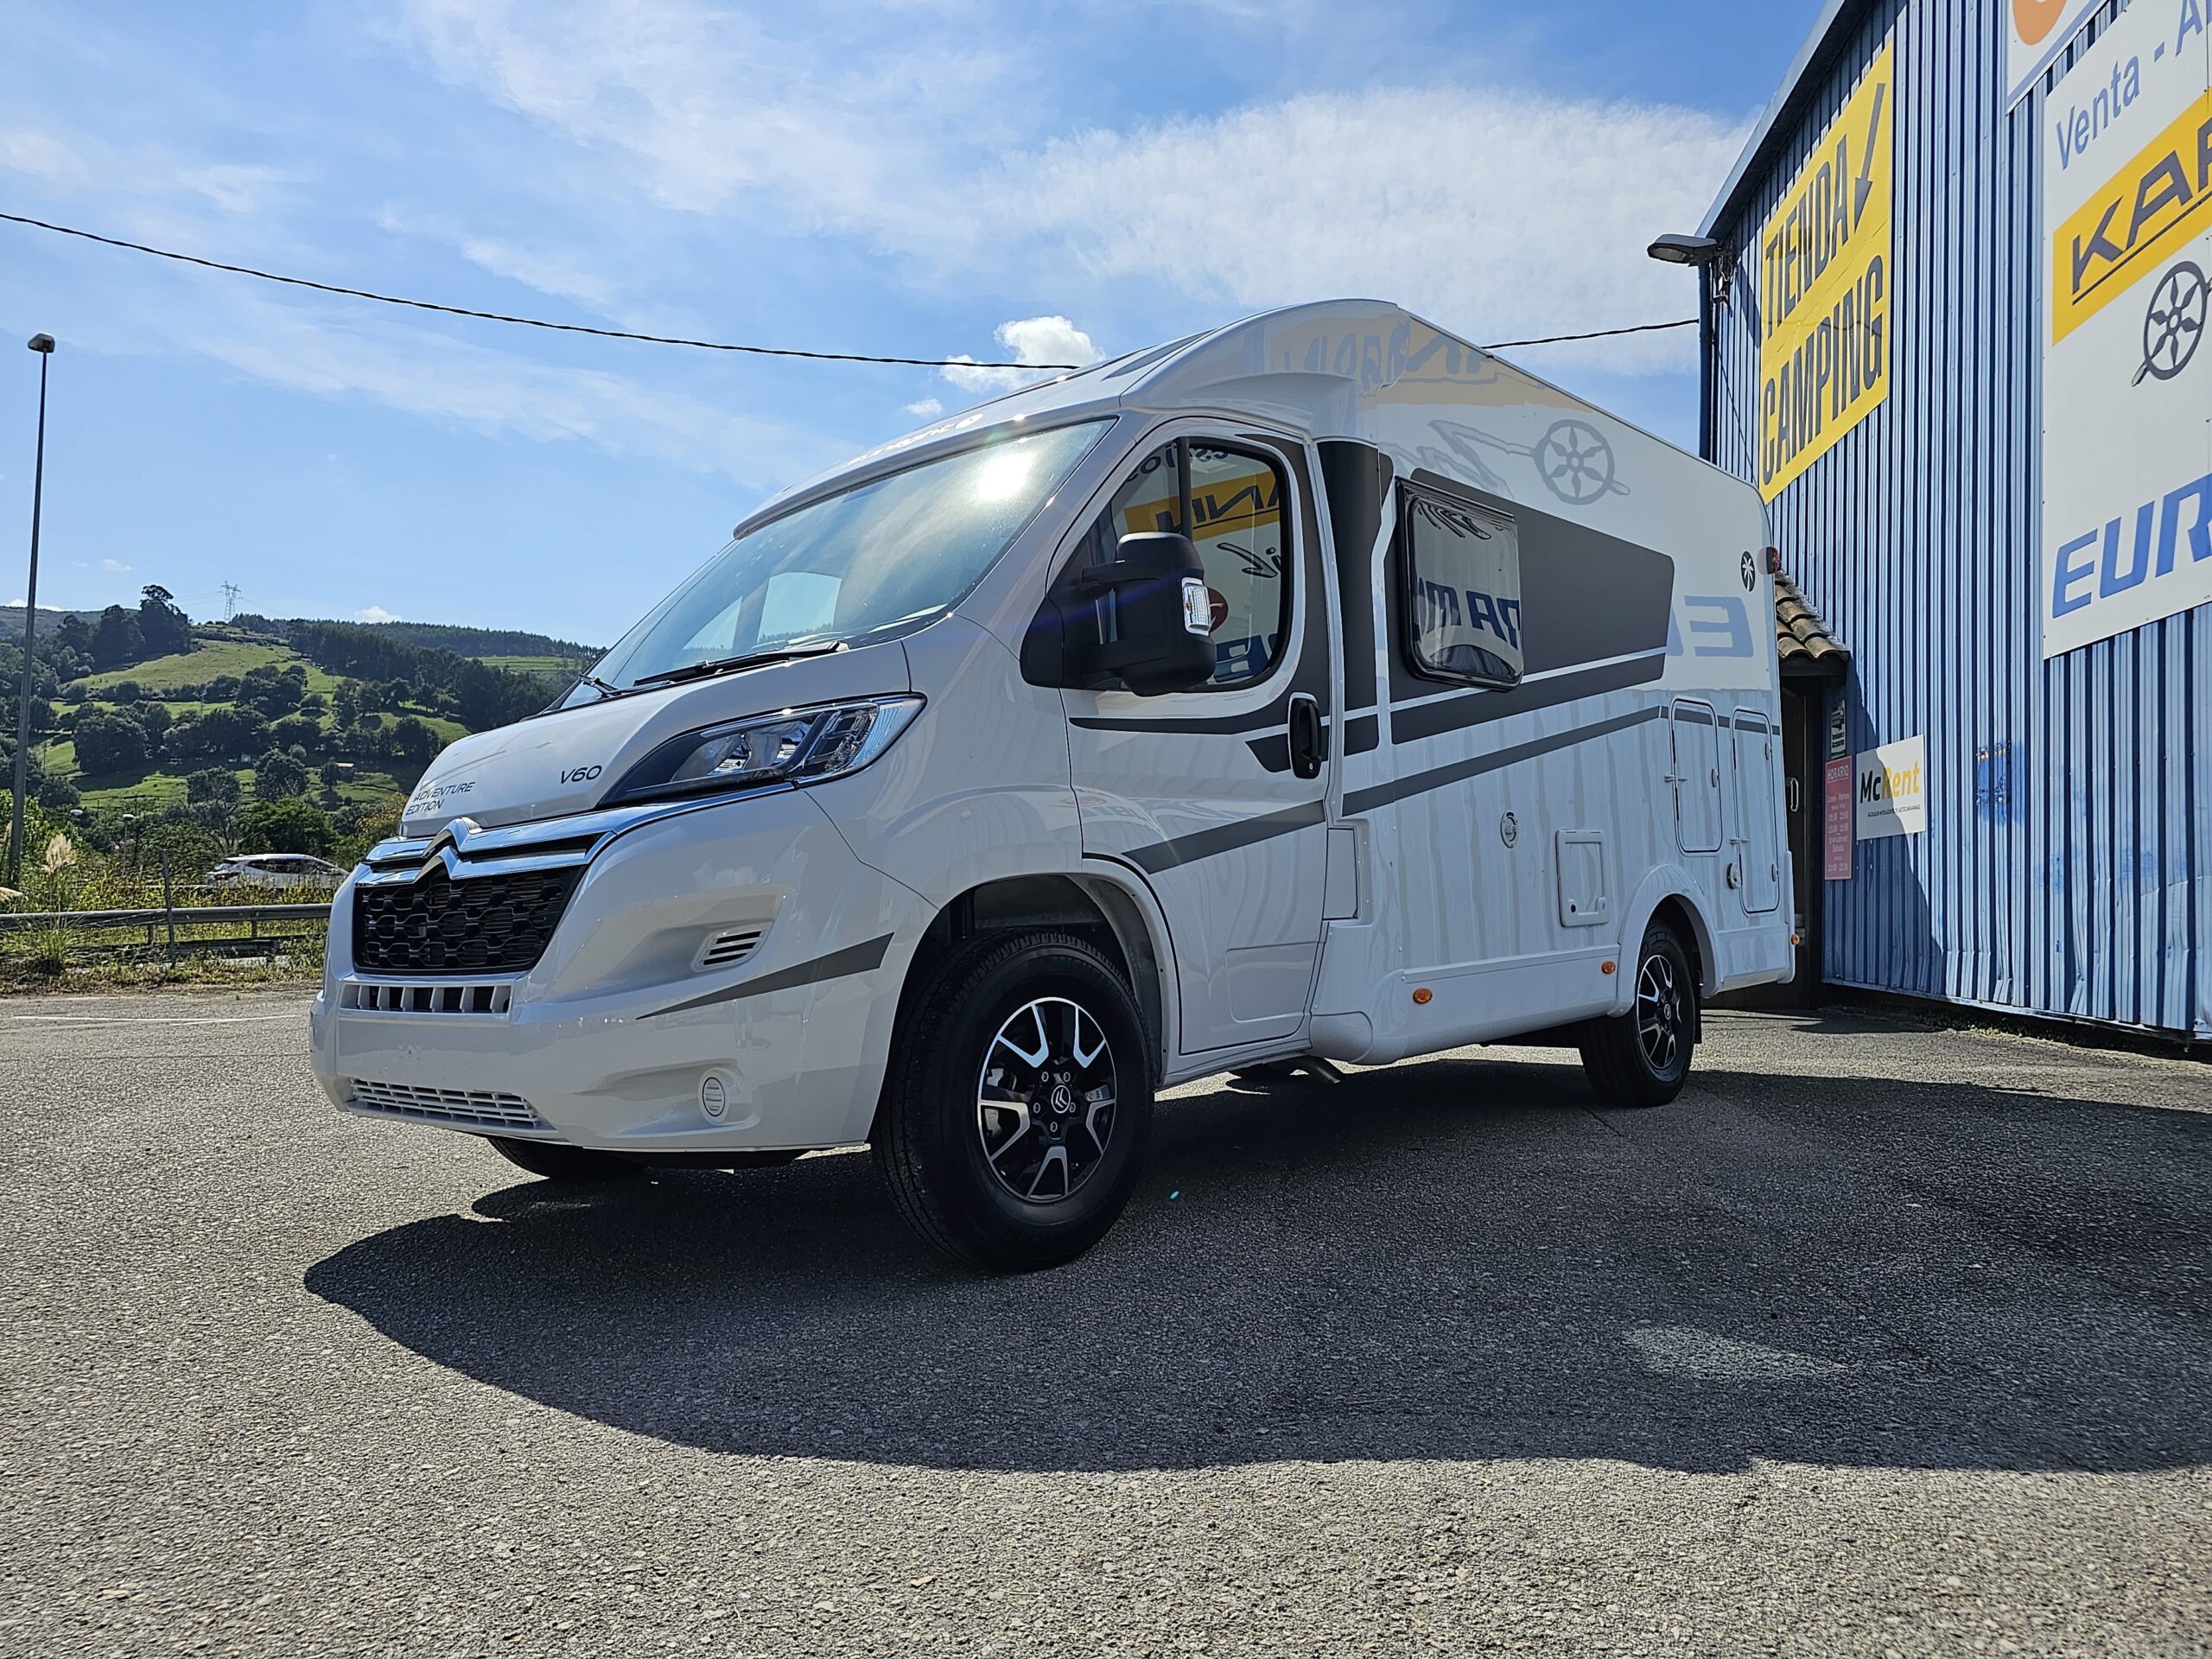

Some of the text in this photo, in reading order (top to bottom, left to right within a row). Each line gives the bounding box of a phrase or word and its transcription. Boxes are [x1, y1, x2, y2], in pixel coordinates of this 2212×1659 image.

[2056, 56, 2140, 171] Venta
[2071, 116, 2212, 296] KA
[1765, 133, 1849, 340] TIENDA
[1762, 254, 1884, 486] CAMPING
[413, 781, 476, 803] ADVENTURE
[560, 765, 603, 785] V60
[1827, 764, 1849, 781] HORARIO
[1859, 760, 1921, 804] McRent
[404, 798, 445, 817] EDITION
